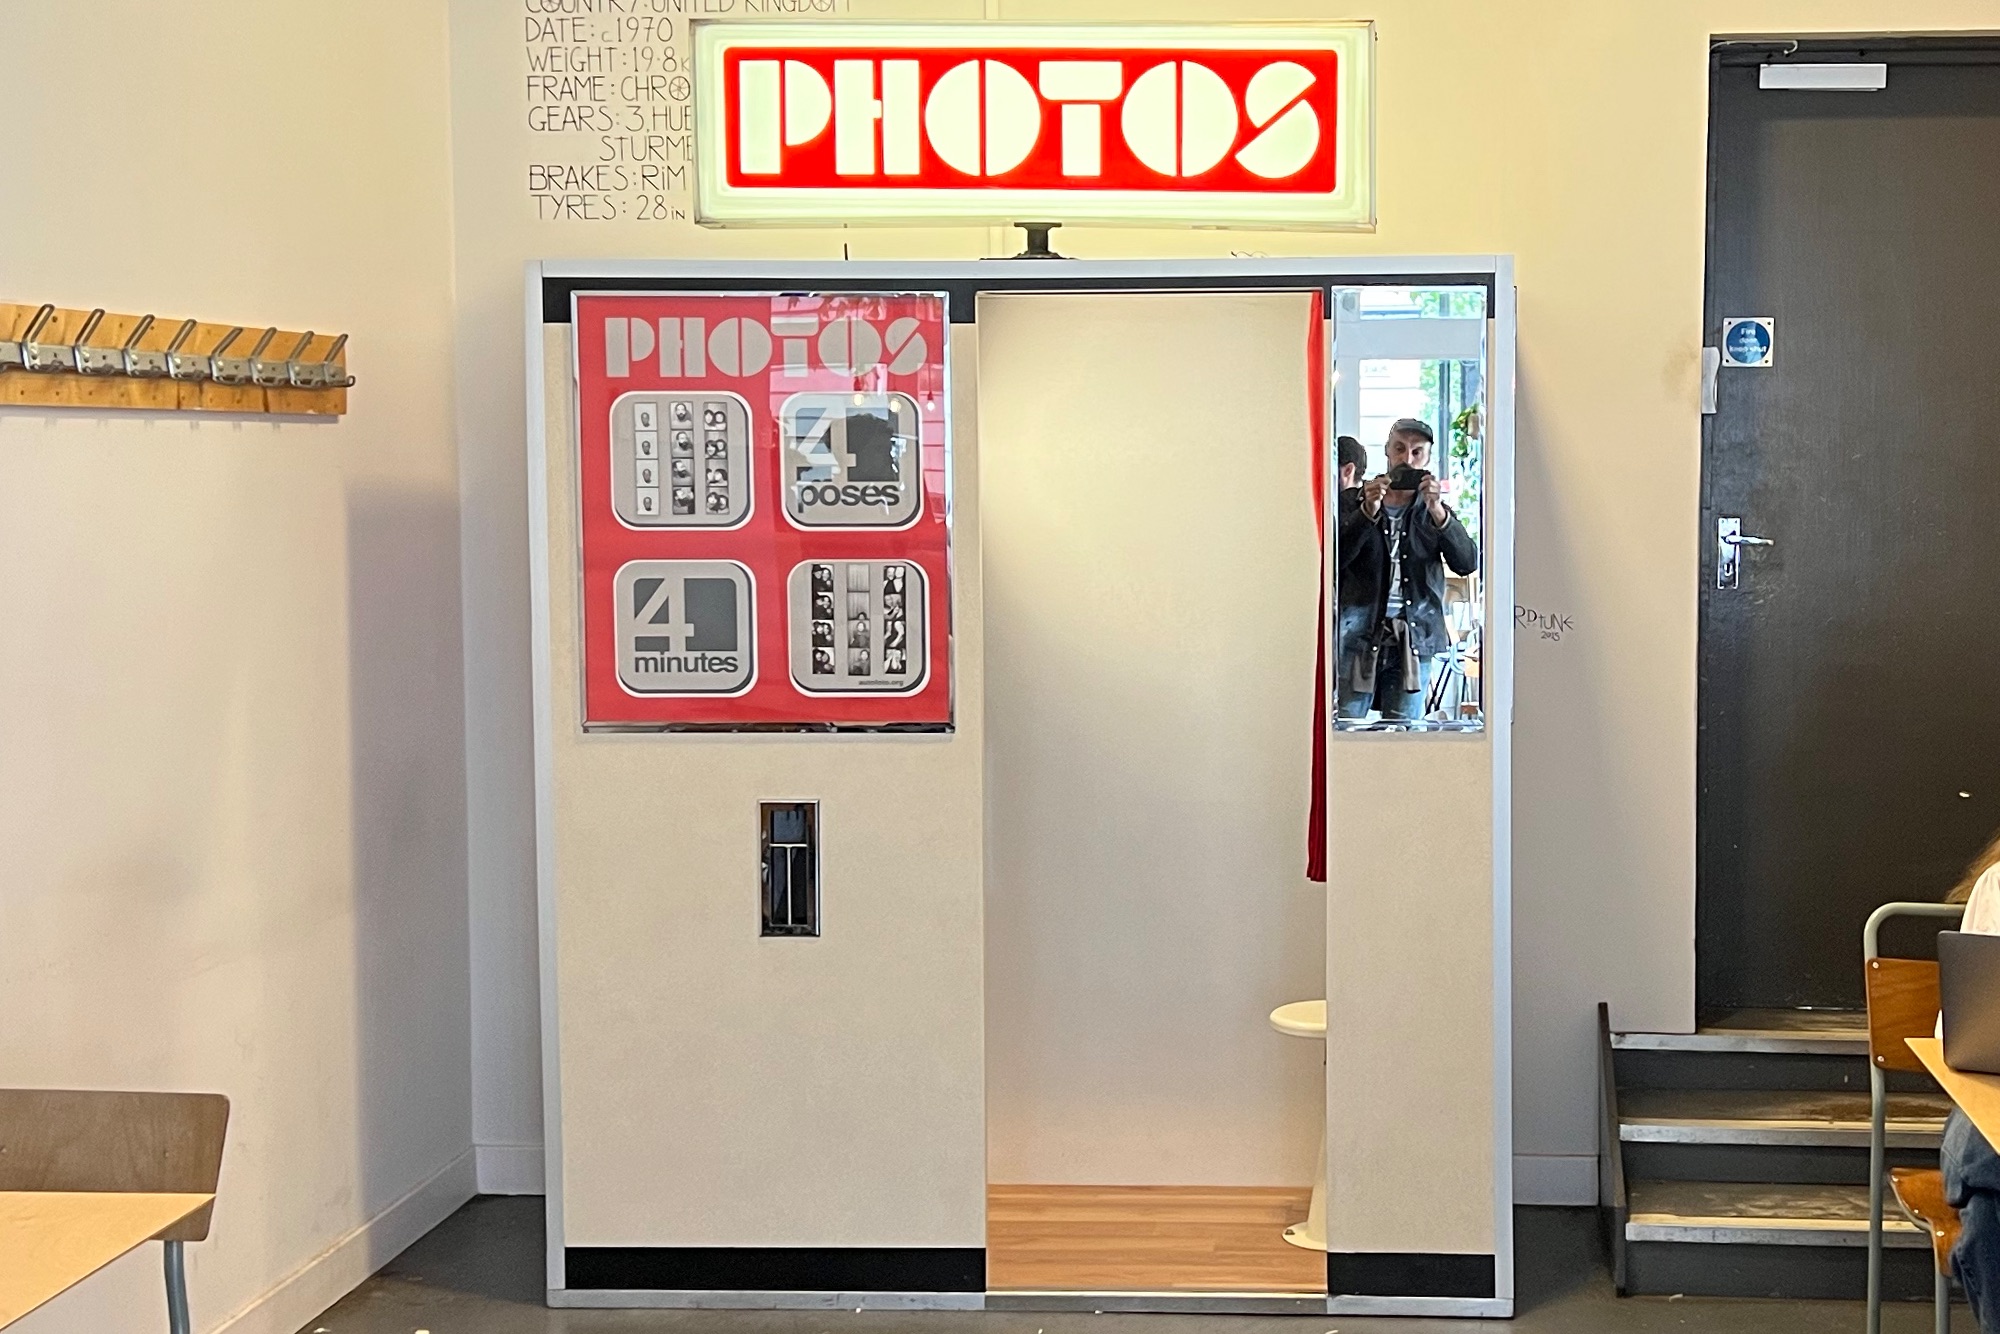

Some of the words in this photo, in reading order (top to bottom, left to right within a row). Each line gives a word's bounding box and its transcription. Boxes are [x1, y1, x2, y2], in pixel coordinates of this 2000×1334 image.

[739, 58, 1320, 179] PHOTOS
[604, 317, 928, 378] PHOTOS
[796, 407, 857, 482] 4
[797, 484, 900, 513] poses
[634, 577, 695, 652] 4
[634, 651, 739, 673] minutes
